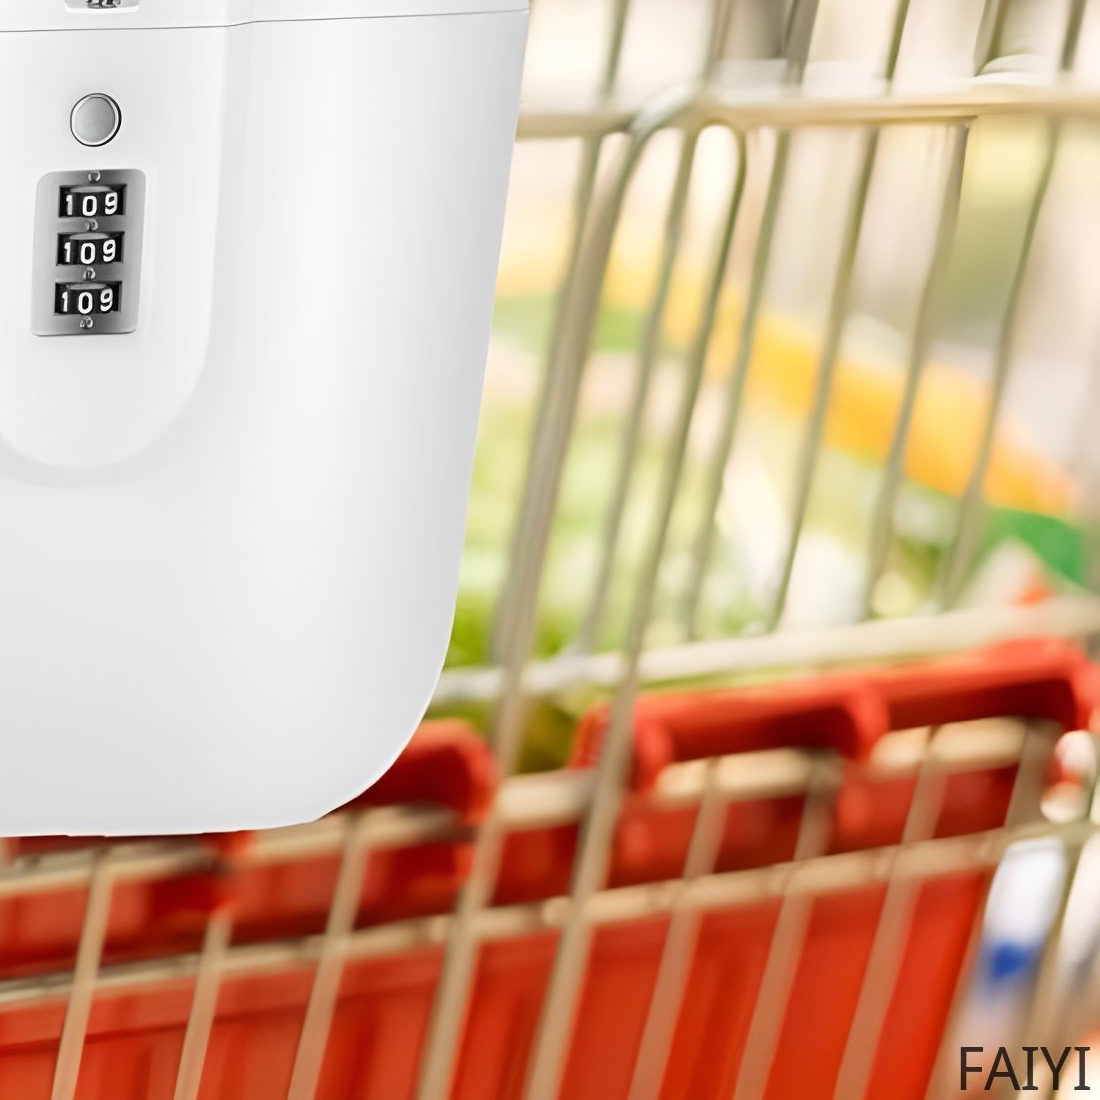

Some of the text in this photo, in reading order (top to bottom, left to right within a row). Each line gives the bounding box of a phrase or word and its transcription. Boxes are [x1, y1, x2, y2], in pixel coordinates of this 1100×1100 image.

[66, 192, 118, 217] 109
[64, 239, 116, 265] 109
[62, 288, 113, 314] 109
